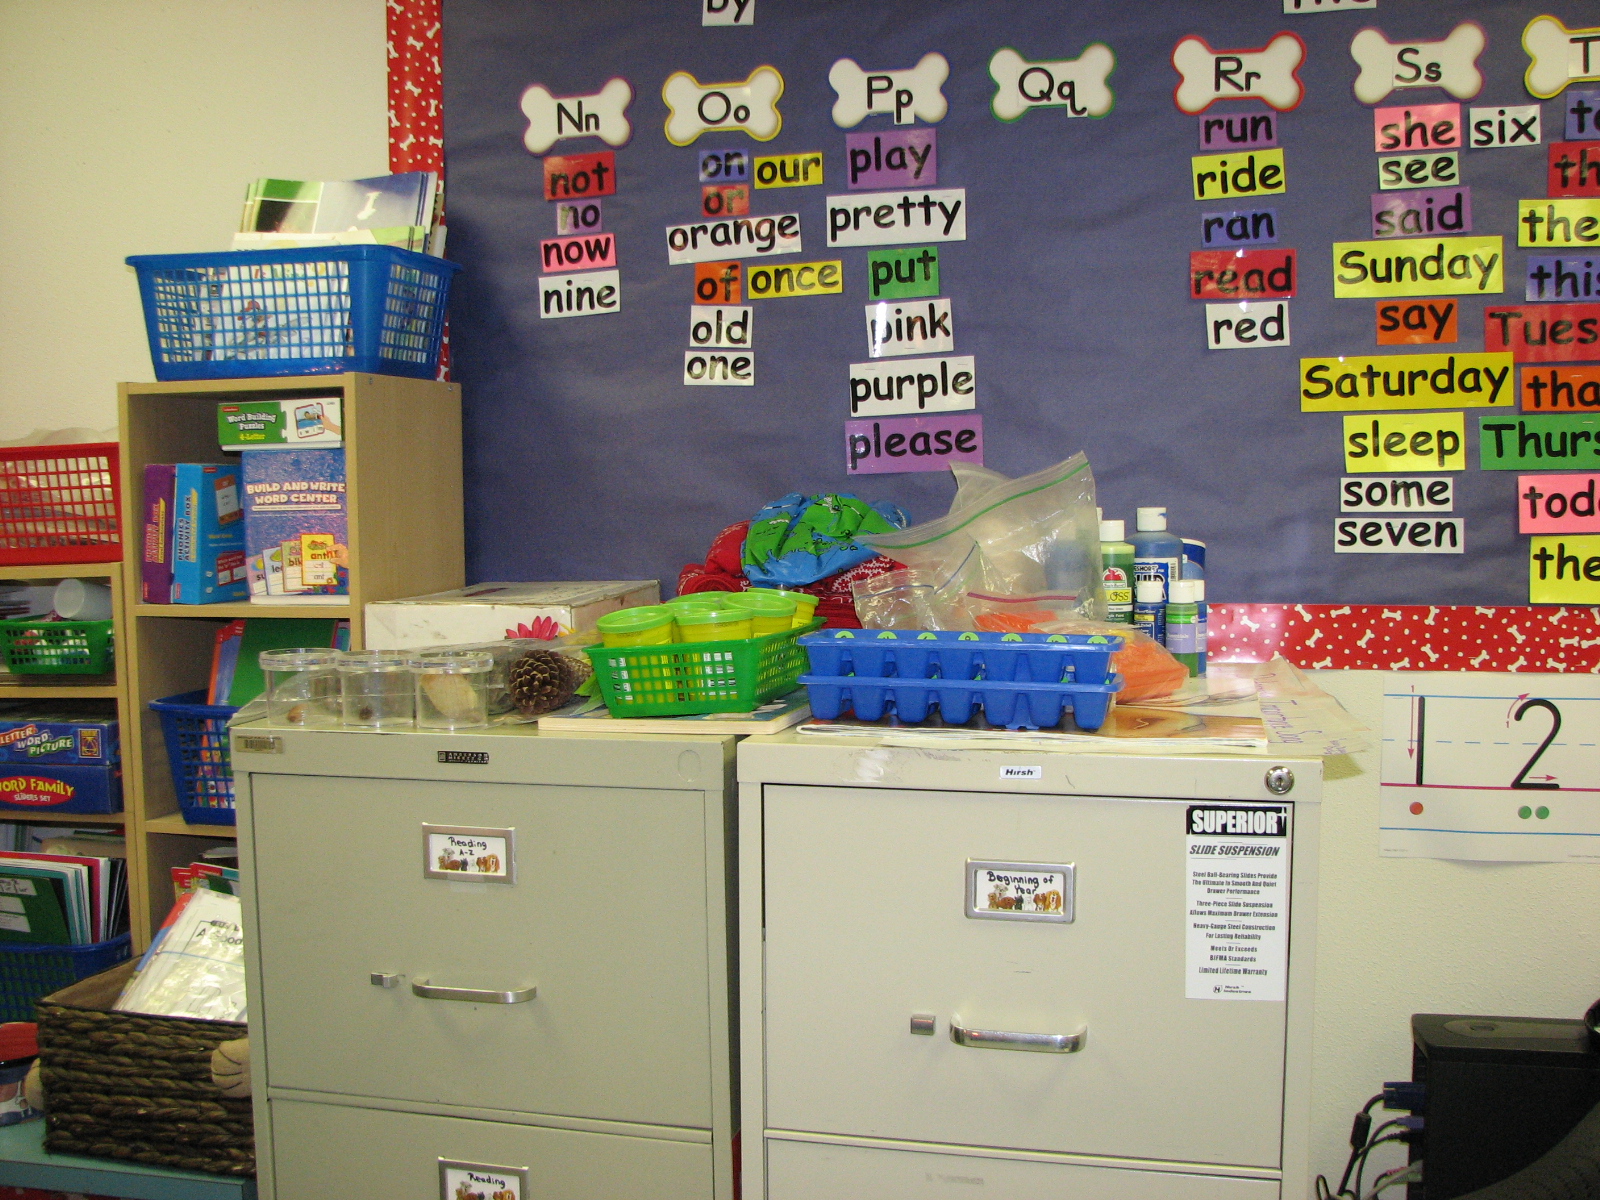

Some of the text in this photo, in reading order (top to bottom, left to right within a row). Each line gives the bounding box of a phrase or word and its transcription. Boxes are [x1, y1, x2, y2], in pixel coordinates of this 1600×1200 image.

[1214, 56, 1261, 92] Rr
[1395, 47, 1442, 83] Ss
[698, 91, 750, 126] Oo
[867, 76, 914, 124] Pp
[1018, 67, 1087, 116] Qq
[557, 100, 600, 135] Nn
[1203, 114, 1273, 145] run
[1380, 111, 1456, 150] she
[1473, 109, 1537, 147] six
[549, 161, 609, 196] not
[701, 152, 745, 179] on
[756, 155, 821, 185] our
[850, 137, 931, 185] play
[1196, 155, 1283, 198] ride
[1381, 156, 1456, 186] see
[560, 203, 600, 230] no
[702, 189, 744, 216] or
[829, 194, 962, 242] pretty
[1375, 193, 1464, 237] said
[668, 214, 800, 253] orange
[1203, 211, 1275, 244] ran
[1521, 204, 1599, 243] the
[543, 238, 612, 268] now
[1337, 243, 1500, 291] Sunday
[697, 264, 738, 303] of
[751, 263, 839, 294] once
[871, 250, 936, 296] put
[1194, 255, 1293, 296] read
[543, 280, 618, 315] nine
[692, 309, 749, 345] old
[870, 302, 951, 352] pink
[1213, 303, 1285, 345] red
[1379, 302, 1455, 341] say
[1488, 311, 1599, 347] Tues
[686, 355, 752, 382] one
[1302, 356, 1510, 404] Saturday
[850, 360, 975, 414] purple
[849, 422, 978, 471] please
[1347, 420, 1460, 468] sleep
[246, 481, 346, 495] BUILD AND WRITE
[254, 493, 338, 504] WORD CENTER
[1342, 479, 1452, 508] some
[1522, 479, 1600, 519] tod
[1337, 520, 1458, 548] seven
[17, 733, 49, 749] WORD
[29, 738, 73, 755] PICTURE
[1416, 696, 1561, 789] 1 2
[1005, 768, 1034, 776] Hirsh
[1192, 809, 1278, 834] SUPERIOR
[448, 836, 487, 850] Reading
[1189, 845, 1280, 857] SLIDE SUSPENSION
[987, 870, 1054, 888] Beginning of
[1014, 885, 1036, 895] Year
[467, 1172, 506, 1189] Reading
